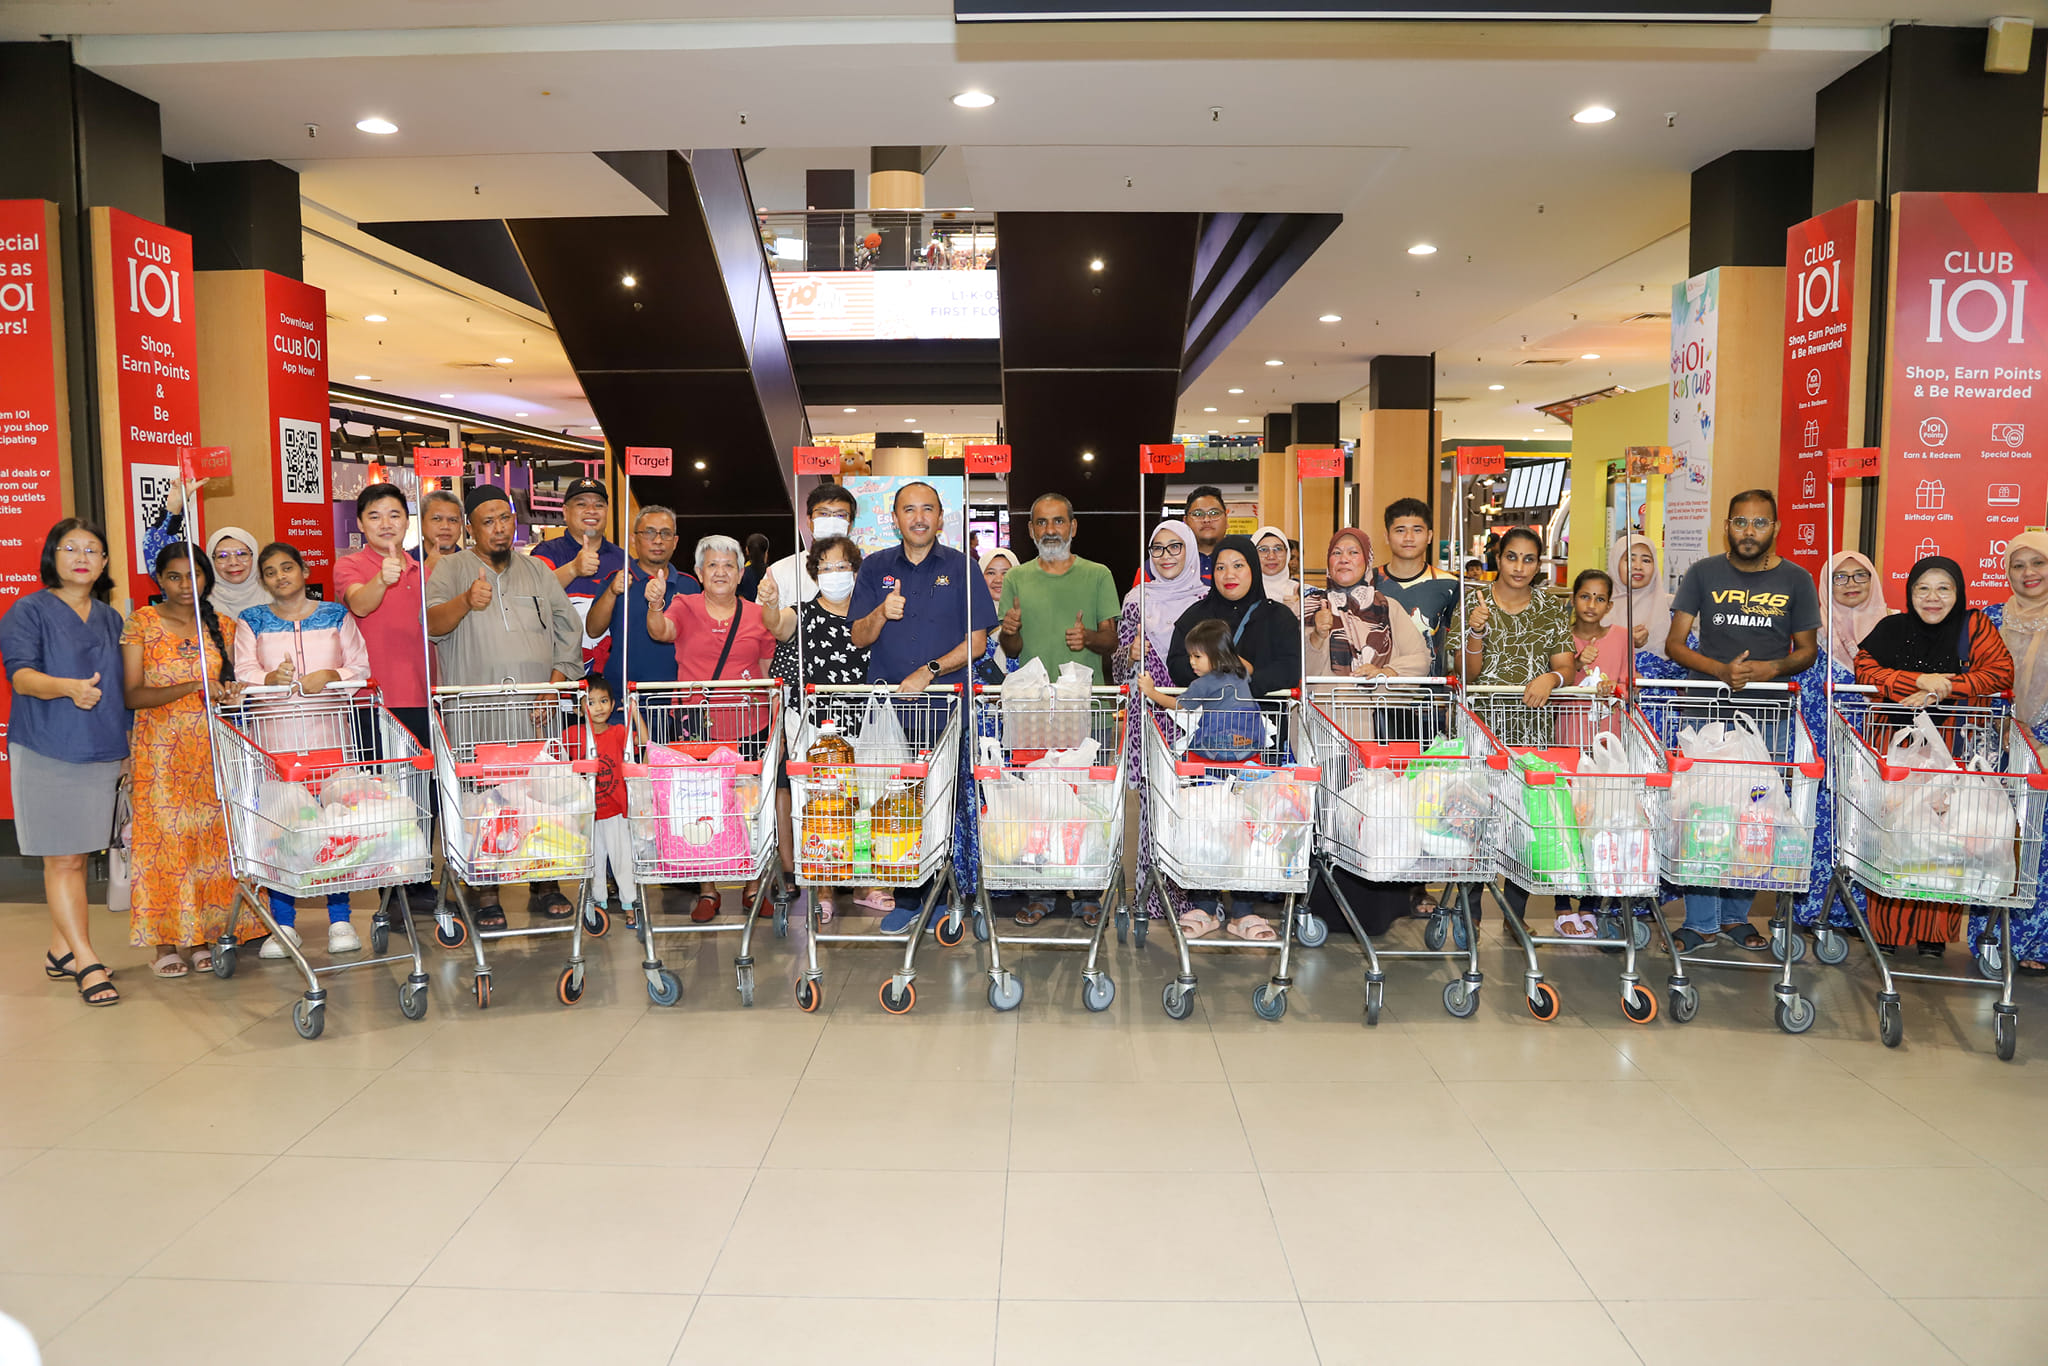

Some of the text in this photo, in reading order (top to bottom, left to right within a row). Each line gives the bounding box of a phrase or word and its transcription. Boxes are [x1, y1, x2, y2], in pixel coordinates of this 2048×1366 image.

[134, 237, 172, 264] CLUB
[1804, 240, 1835, 266] CLUB
[11, 263, 32, 276] as
[1944, 250, 2014, 274] CLUB
[128, 257, 182, 324] IOI
[786, 281, 822, 310] HOT
[1796, 259, 1841, 323] IOI
[930, 306, 968, 316] FIRST
[1926, 278, 2029, 344] IOI
[280, 312, 314, 331] Download
[1788, 322, 1848, 346] Shop, Earn Points
[141, 335, 175, 358] Shop,
[274, 334, 322, 361] CLUB IOI
[1792, 337, 1843, 360] & Be Rewarded
[122, 354, 190, 381] Earn Points
[282, 360, 316, 376] App Now!
[1906, 366, 2042, 382] Shop, Earn Points
[156, 384, 165, 398] &
[1673, 374, 1690, 400] KIDS
[1914, 385, 2032, 398] & Be Rewarded
[154, 406, 169, 421] Be
[4, 422, 49, 433] you shop
[130, 426, 193, 446] Rewarded!
[632, 455, 670, 468] Target
[800, 454, 837, 468] Target
[1147, 452, 1182, 466] Target
[1981, 451, 2009, 459] Special
[12, 469, 37, 478] deals
[12, 493, 46, 502] outlets
[1904, 514, 1935, 522] Birthday
[1990, 540, 2009, 555] IO
[1980, 557, 1997, 569] KIDS
[6, 574, 37, 582] rebate
[1726, 614, 1772, 627] YAMAHA
